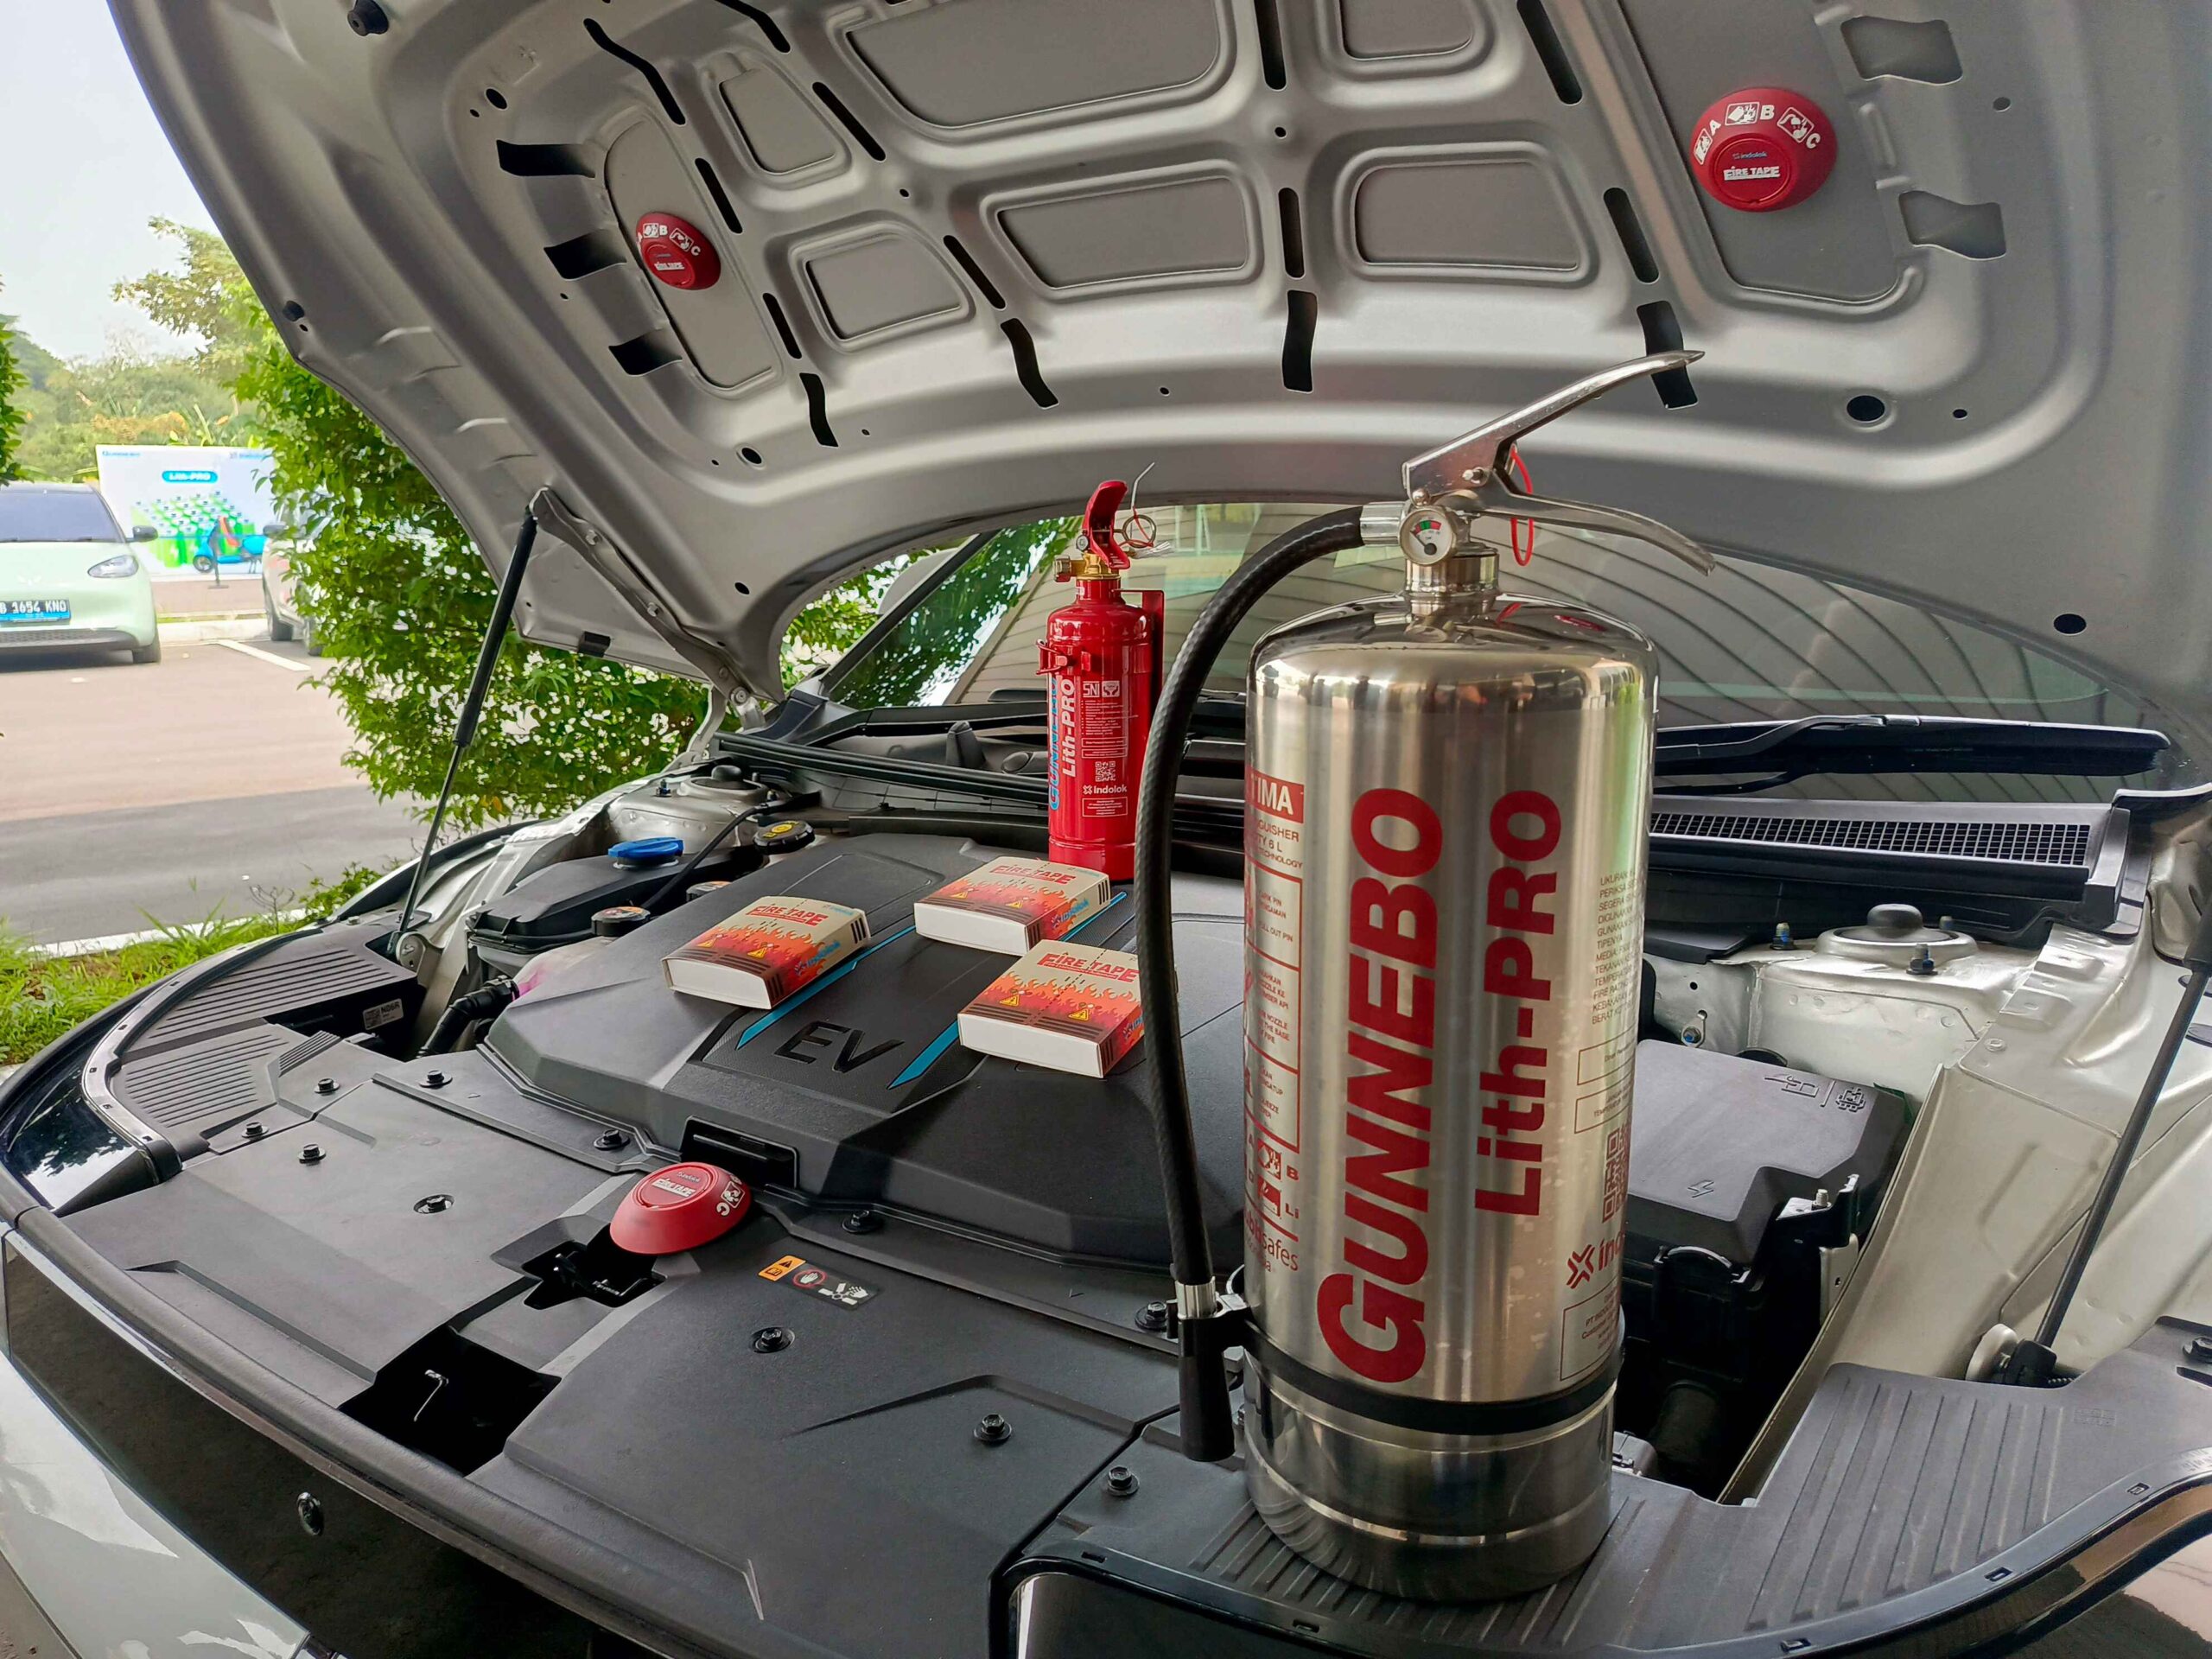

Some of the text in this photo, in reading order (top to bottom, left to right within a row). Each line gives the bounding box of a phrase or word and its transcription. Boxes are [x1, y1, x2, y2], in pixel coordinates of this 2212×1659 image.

[1710, 105, 1821, 149] A B C
[1723, 166, 1780, 181] FIRE TAPE
[659, 225, 668, 236] B
[691, 246, 701, 256] C
[1083, 681, 1100, 697] SNI
[1061, 678, 1076, 777] Lith-PRO
[1255, 780, 1294, 815] IMA
[1268, 839, 1274, 850] 6
[1276, 842, 1282, 853] L
[989, 864, 1030, 874] FIRE
[1031, 869, 1077, 885] TAPE
[747, 904, 783, 917] FIRE
[785, 906, 829, 927] TAPE
[1037, 952, 1140, 983] FIRE TAPE
[1475, 790, 1561, 1216] Lith-PRO
[1593, 988, 1608, 1000] FIRE
[773, 1020, 906, 1073] EV
[1317, 788, 1443, 1382] GUNNEBO
[1286, 1164, 1299, 1180] B
[716, 1202, 730, 1216] C
[1286, 1203, 1299, 1219] Li
